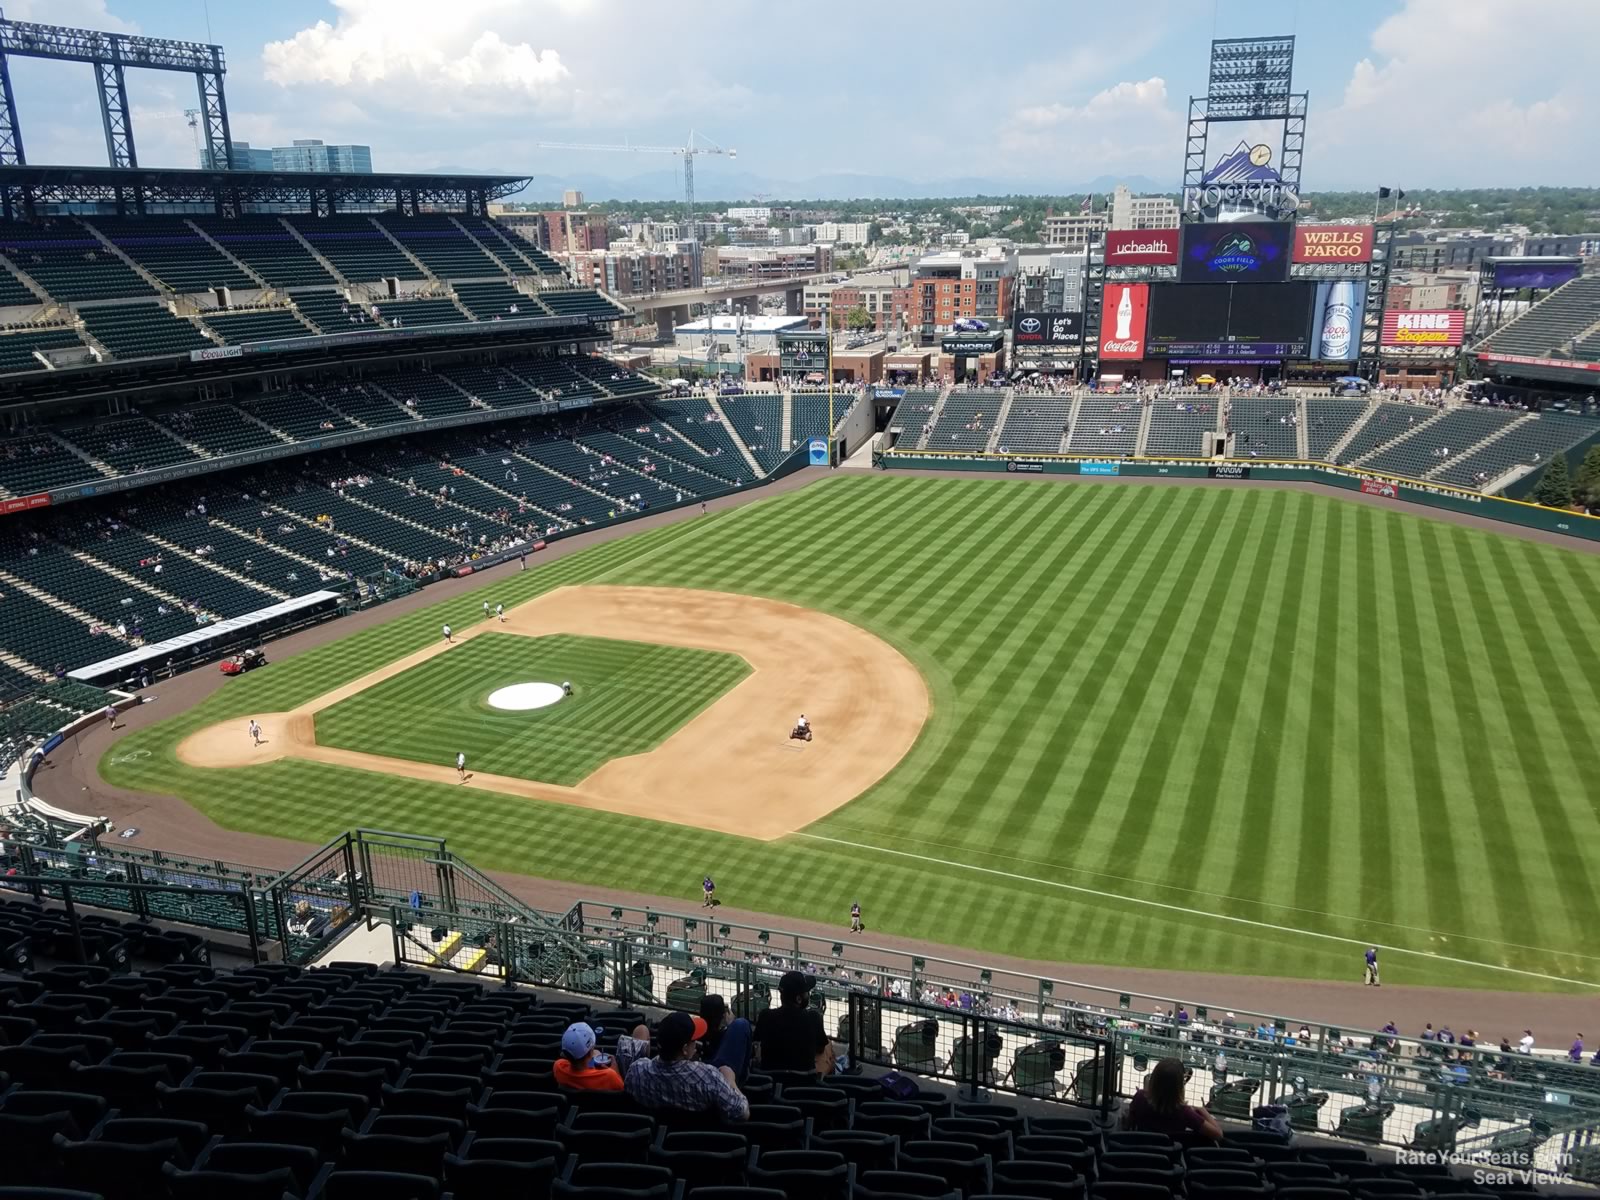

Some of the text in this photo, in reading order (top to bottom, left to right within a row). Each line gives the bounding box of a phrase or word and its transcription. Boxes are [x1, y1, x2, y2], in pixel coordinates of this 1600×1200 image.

[1184, 184, 1300, 212] ROCKIES
[1304, 232, 1363, 243] WELLS
[1117, 240, 1168, 253] uchealth
[1304, 245, 1361, 257] FARGO
[1397, 314, 1450, 329] KING
[1323, 324, 1349, 335] Coors
[1395, 328, 1450, 344] Soopers
[1104, 340, 1139, 353] Coca-Cola
[201, 348, 242, 359] Coors LIGHT
[67, 491, 80, 500] you
[95, 481, 130, 493] something
[130, 475, 163, 488] suspicious
[163, 472, 172, 480] on
[173, 469, 187, 479] your
[188, 466, 200, 476] way
[208, 461, 218, 469] the
[219, 459, 234, 469] game
[242, 454, 256, 464] here
[263, 450, 272, 459] the
